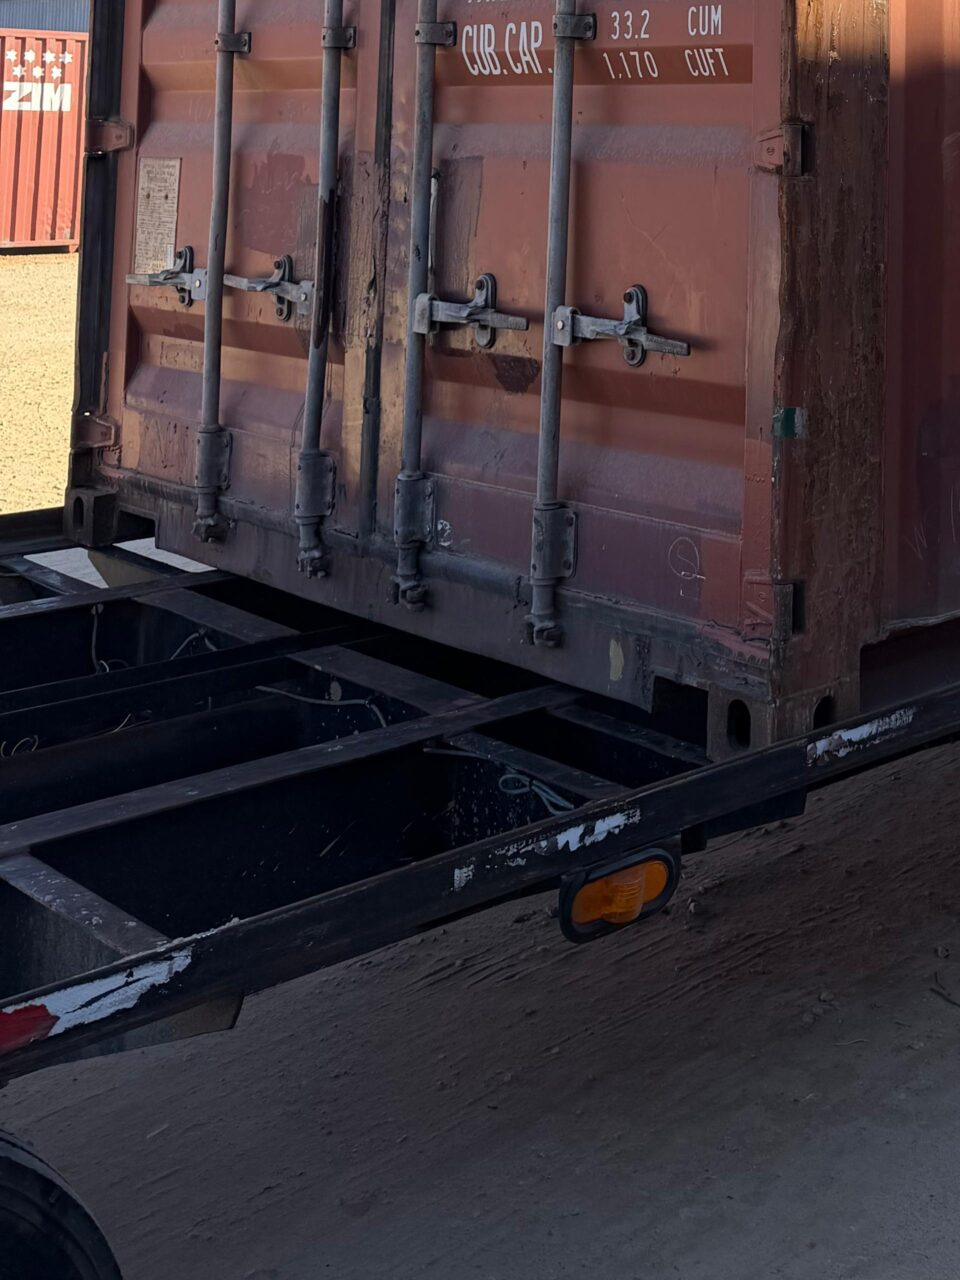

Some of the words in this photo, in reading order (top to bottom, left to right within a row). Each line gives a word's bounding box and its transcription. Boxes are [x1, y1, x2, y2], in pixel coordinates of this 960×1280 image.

[610, 8, 651, 40] 33.2
[687, 4, 722, 37] CUM
[602, 50, 659, 80] 1,170
[684, 47, 729, 77] CUFT
[2, 81, 72, 112] ZIM
